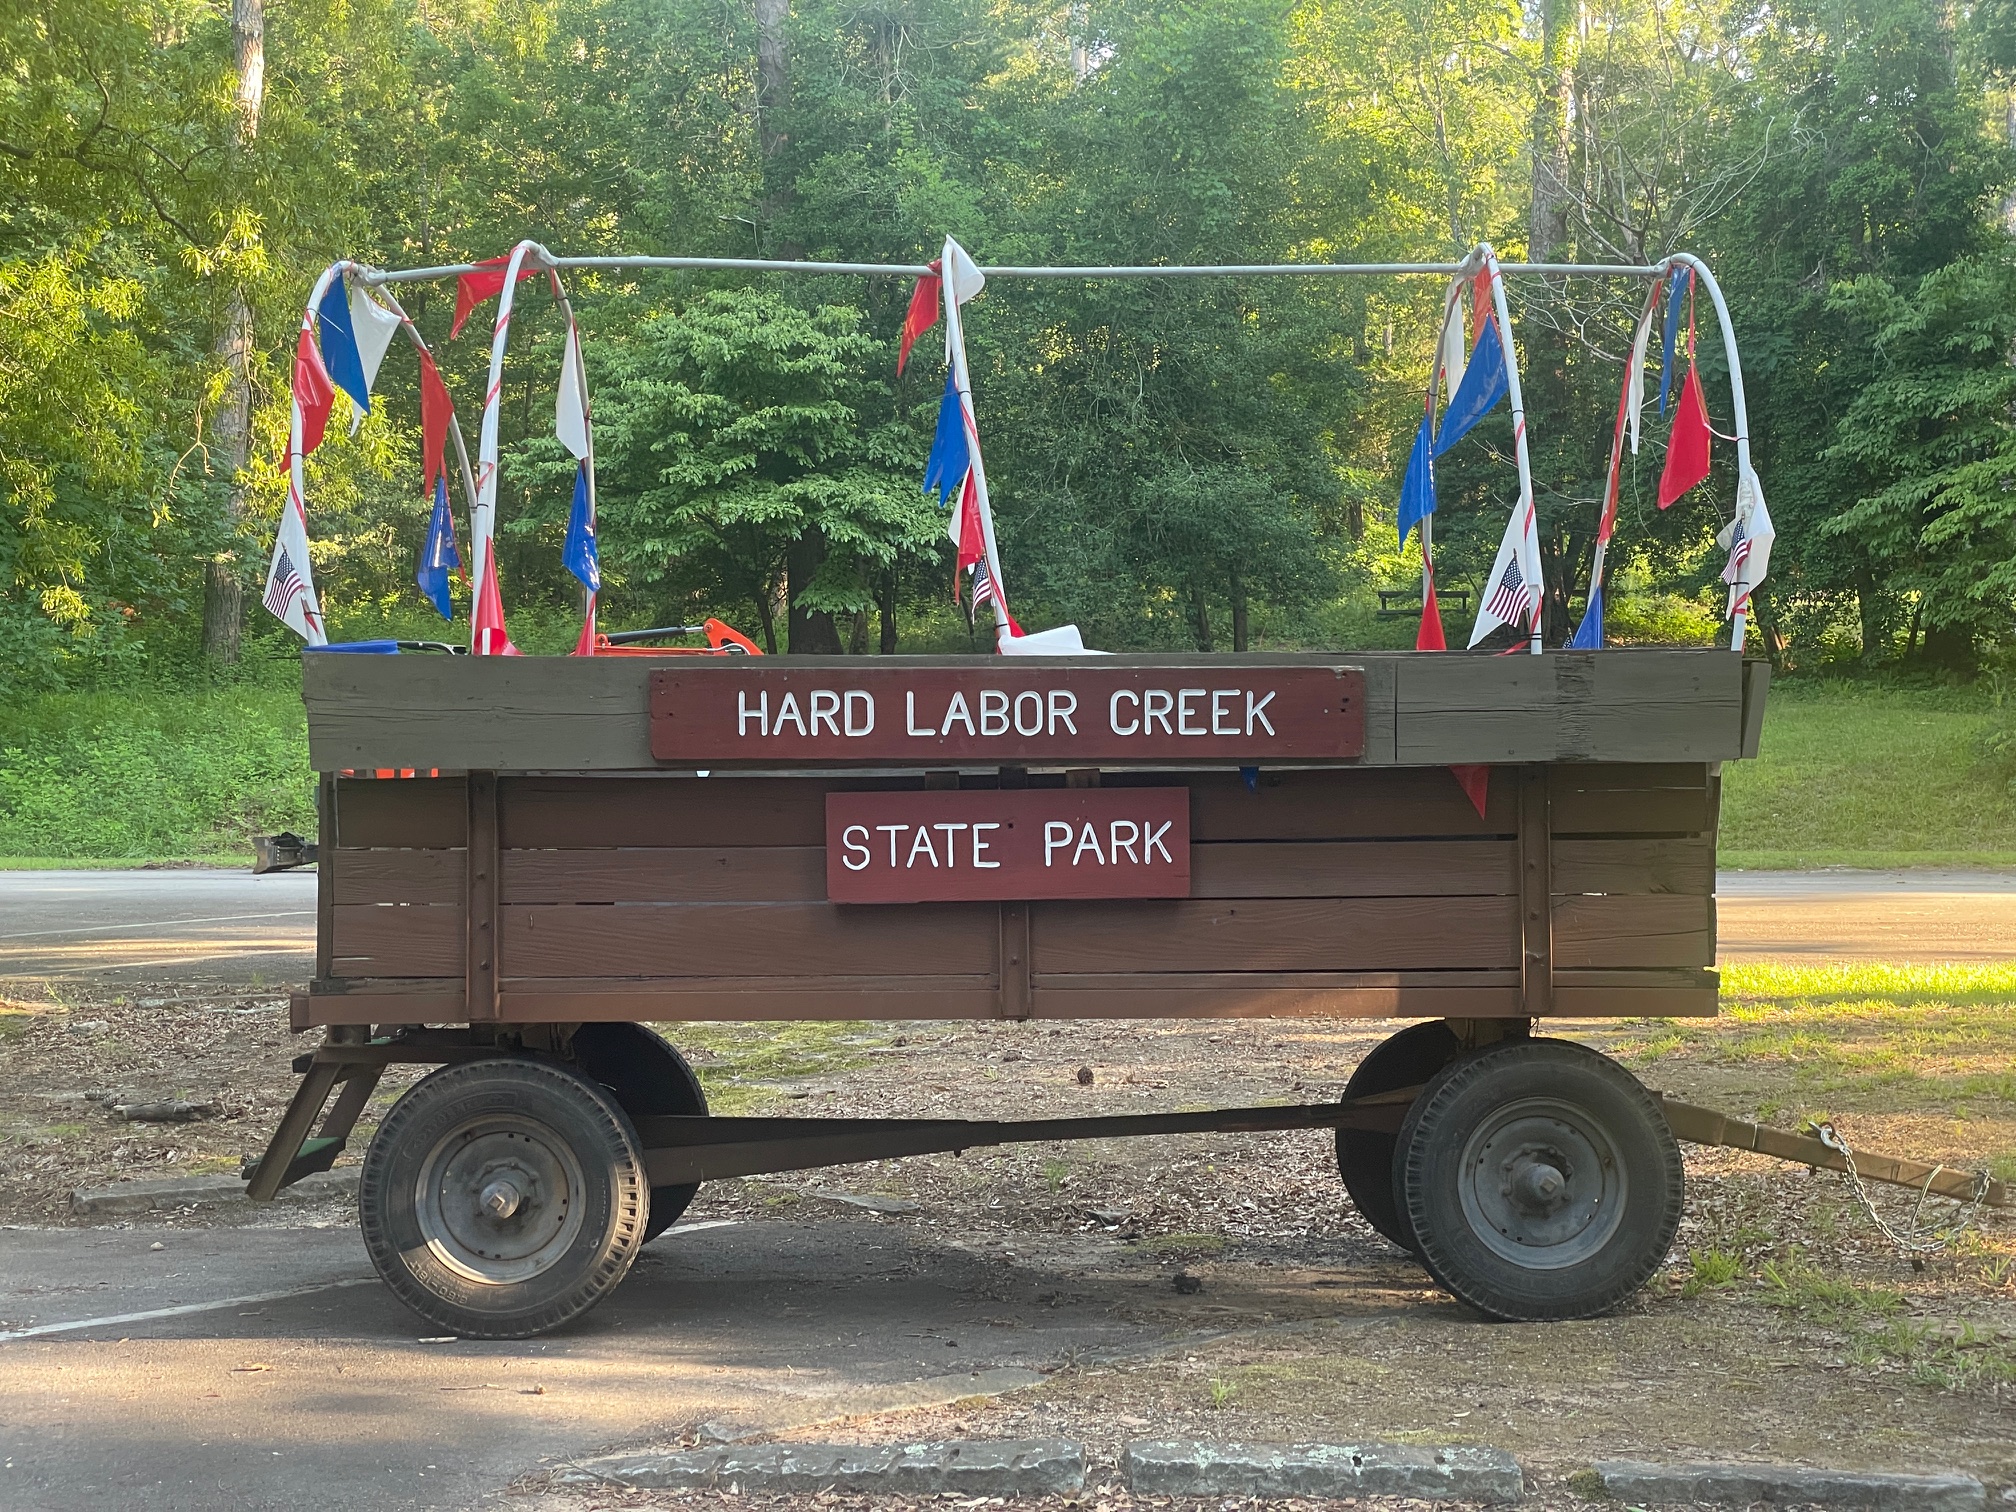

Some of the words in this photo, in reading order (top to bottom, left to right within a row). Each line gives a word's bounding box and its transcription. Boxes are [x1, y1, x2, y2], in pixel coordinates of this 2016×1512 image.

[738, 689, 875, 737] HARD
[905, 689, 1078, 737] LABOR
[1109, 688, 1276, 737] CREEK
[842, 822, 1001, 871] STATE
[1044, 820, 1173, 867] PARK
